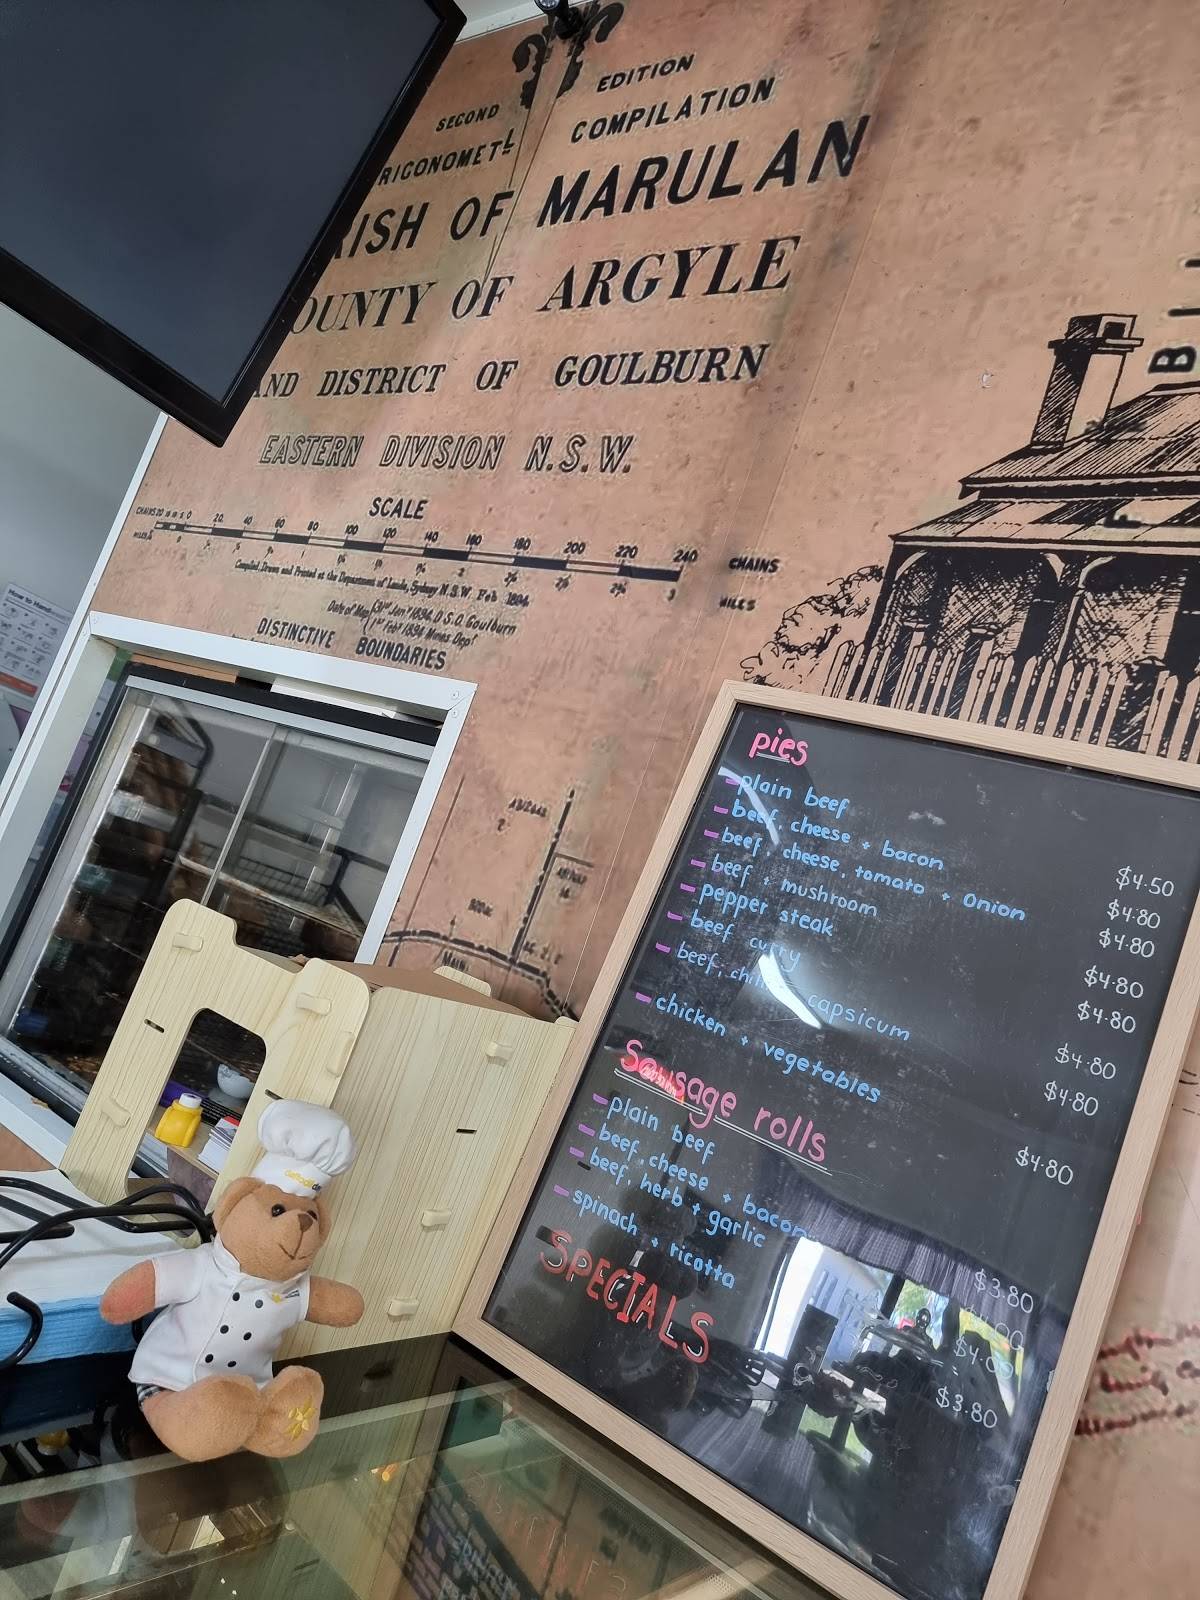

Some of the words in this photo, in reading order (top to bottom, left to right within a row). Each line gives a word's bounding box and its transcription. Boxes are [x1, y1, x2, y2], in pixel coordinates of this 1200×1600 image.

[436, 104, 500, 131] SECOND
[597, 54, 695, 93] EDITION
[571, 77, 775, 145] COMPILATION
[450, 191, 515, 241] OF
[537, 116, 872, 228] MARULAN
[451, 276, 514, 320] OF
[537, 235, 801, 312] ARGYLE
[317, 364, 446, 396] DISTRICT
[476, 360, 517, 391] OF
[555, 343, 769, 388] GOULBURN
[259, 434, 364, 467] EASTERN
[379, 434, 505, 470] DIVISION
[525, 434, 633, 473] N.S.W.
[369, 497, 428, 519] SCALE
[307, 521, 319, 531] 80
[345, 524, 358, 535] 100
[383, 527, 397, 538] 120
[424, 531, 438, 543] 140
[564, 542, 585, 555] 200
[615, 545, 638, 559] 220
[673, 549, 698, 562] 240
[729, 557, 780, 573] CHAINS
[257, 617, 335, 649] DISTINCTIVE
[356, 636, 446, 670] BOUNDARIES
[466, 614, 517, 635] Goulburn
[749, 728, 808, 766] pies
[737, 774, 792, 800] plain
[804, 787, 850, 819] beef
[791, 815, 851, 843] cheese
[882, 840, 944, 871] bacon
[711, 853, 753, 888] beef
[780, 877, 878, 917] mushroom
[855, 865, 925, 896] tomato
[1116, 865, 1175, 897] $4.50
[699, 883, 769, 918] pepper
[779, 907, 834, 937] steak
[1107, 898, 1161, 929] $4.80
[690, 909, 735, 943] beef
[750, 937, 801, 973] curry
[1099, 927, 1155, 958] $4.80
[1084, 965, 1144, 999] $4.80
[806, 993, 910, 1042] capsicum
[1077, 1000, 1136, 1034] $4.80
[656, 992, 726, 1037] chicken
[763, 1041, 881, 1103] vegetables
[1055, 1043, 1116, 1080] $4.80
[1044, 1080, 1099, 1117] $4.80
[607, 1096, 659, 1132] plain
[671, 1125, 716, 1164] beef
[753, 1107, 826, 1162] rolls
[1016, 1146, 1074, 1186] $4.80
[640, 1172, 683, 1208] herb
[706, 1210, 766, 1248] garlic
[649, 1150, 709, 1192] cheese
[743, 1193, 808, 1239] bacon
[573, 1188, 638, 1236] spinach
[669, 1243, 737, 1289] ricotta
[539, 1229, 716, 1363] SPECIALS
[974, 1268, 1034, 1314] $3.80
[935, 1386, 998, 1429] $3.80
